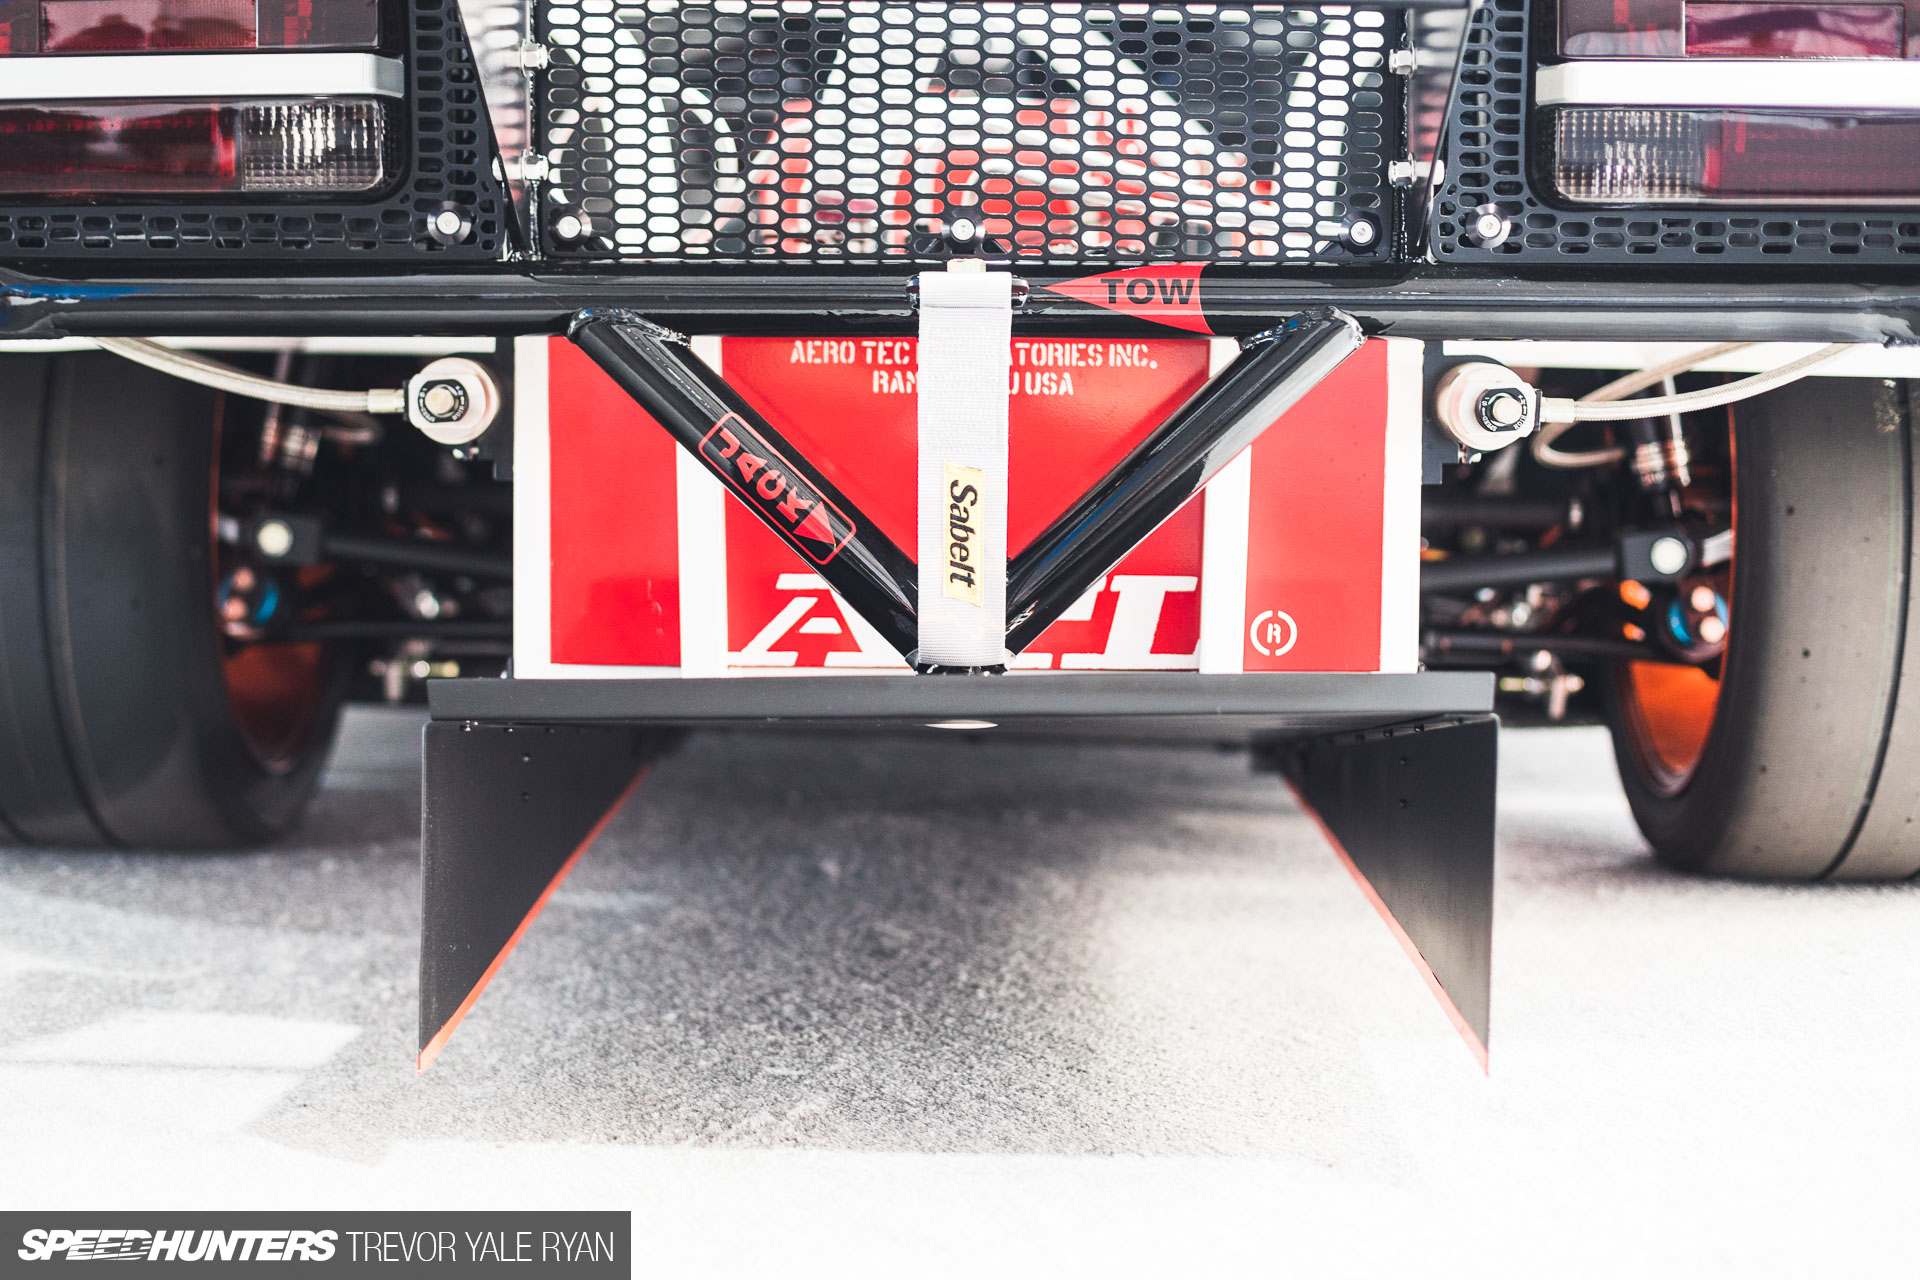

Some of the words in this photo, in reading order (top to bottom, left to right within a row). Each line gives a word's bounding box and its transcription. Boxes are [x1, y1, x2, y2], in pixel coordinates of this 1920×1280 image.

[1101, 278, 1195, 305] TOW
[790, 340, 856, 364] AERO
[861, 340, 910, 365] TEC
[1010, 343, 1103, 367] TORIES
[1109, 343, 1158, 369] INC.
[1025, 371, 1074, 396] USA
[718, 427, 815, 524] JACK
[950, 479, 978, 589] Sabelt
